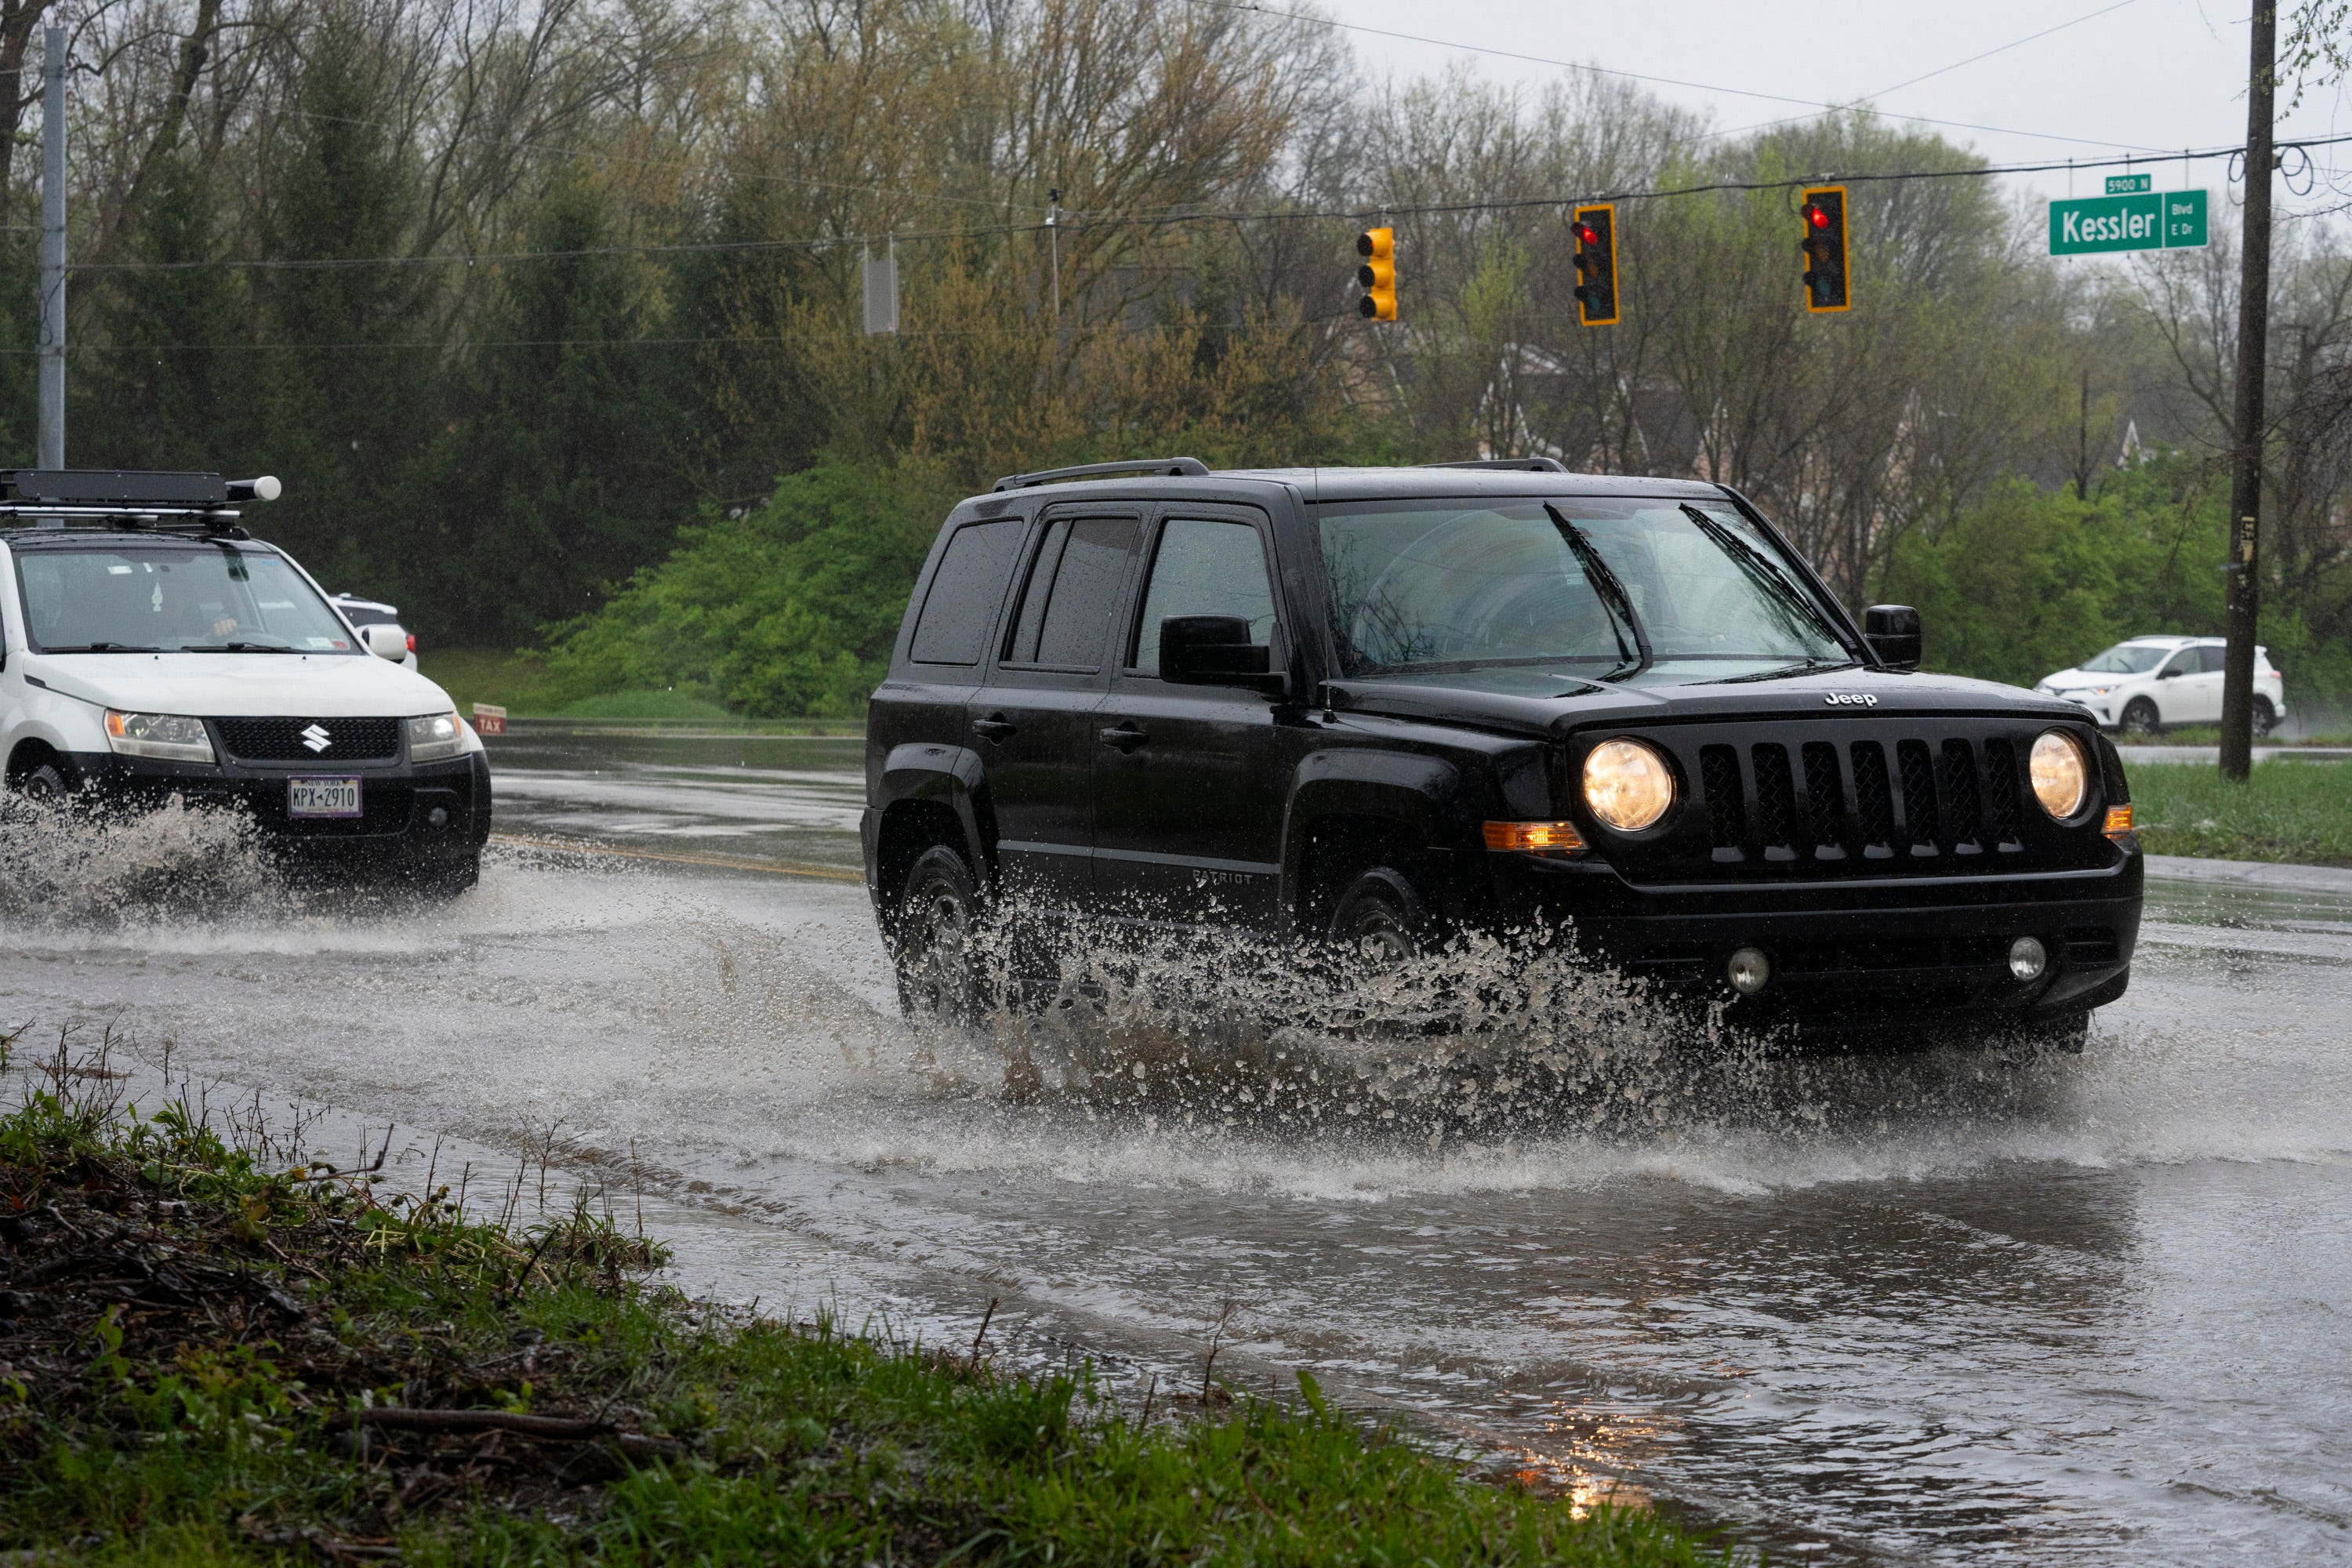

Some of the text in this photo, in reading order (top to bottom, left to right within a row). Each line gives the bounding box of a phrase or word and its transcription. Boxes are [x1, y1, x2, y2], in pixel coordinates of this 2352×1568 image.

[2107, 177, 2149, 192] 5900 N
[2171, 202, 2194, 216] Blvd
[2063, 207, 2155, 244] Kessler
[2171, 223, 2194, 236] E Dr
[1824, 692, 1878, 707] Jeep
[480, 718, 501, 733] TAX
[1192, 869, 1253, 885] PATRIOT
